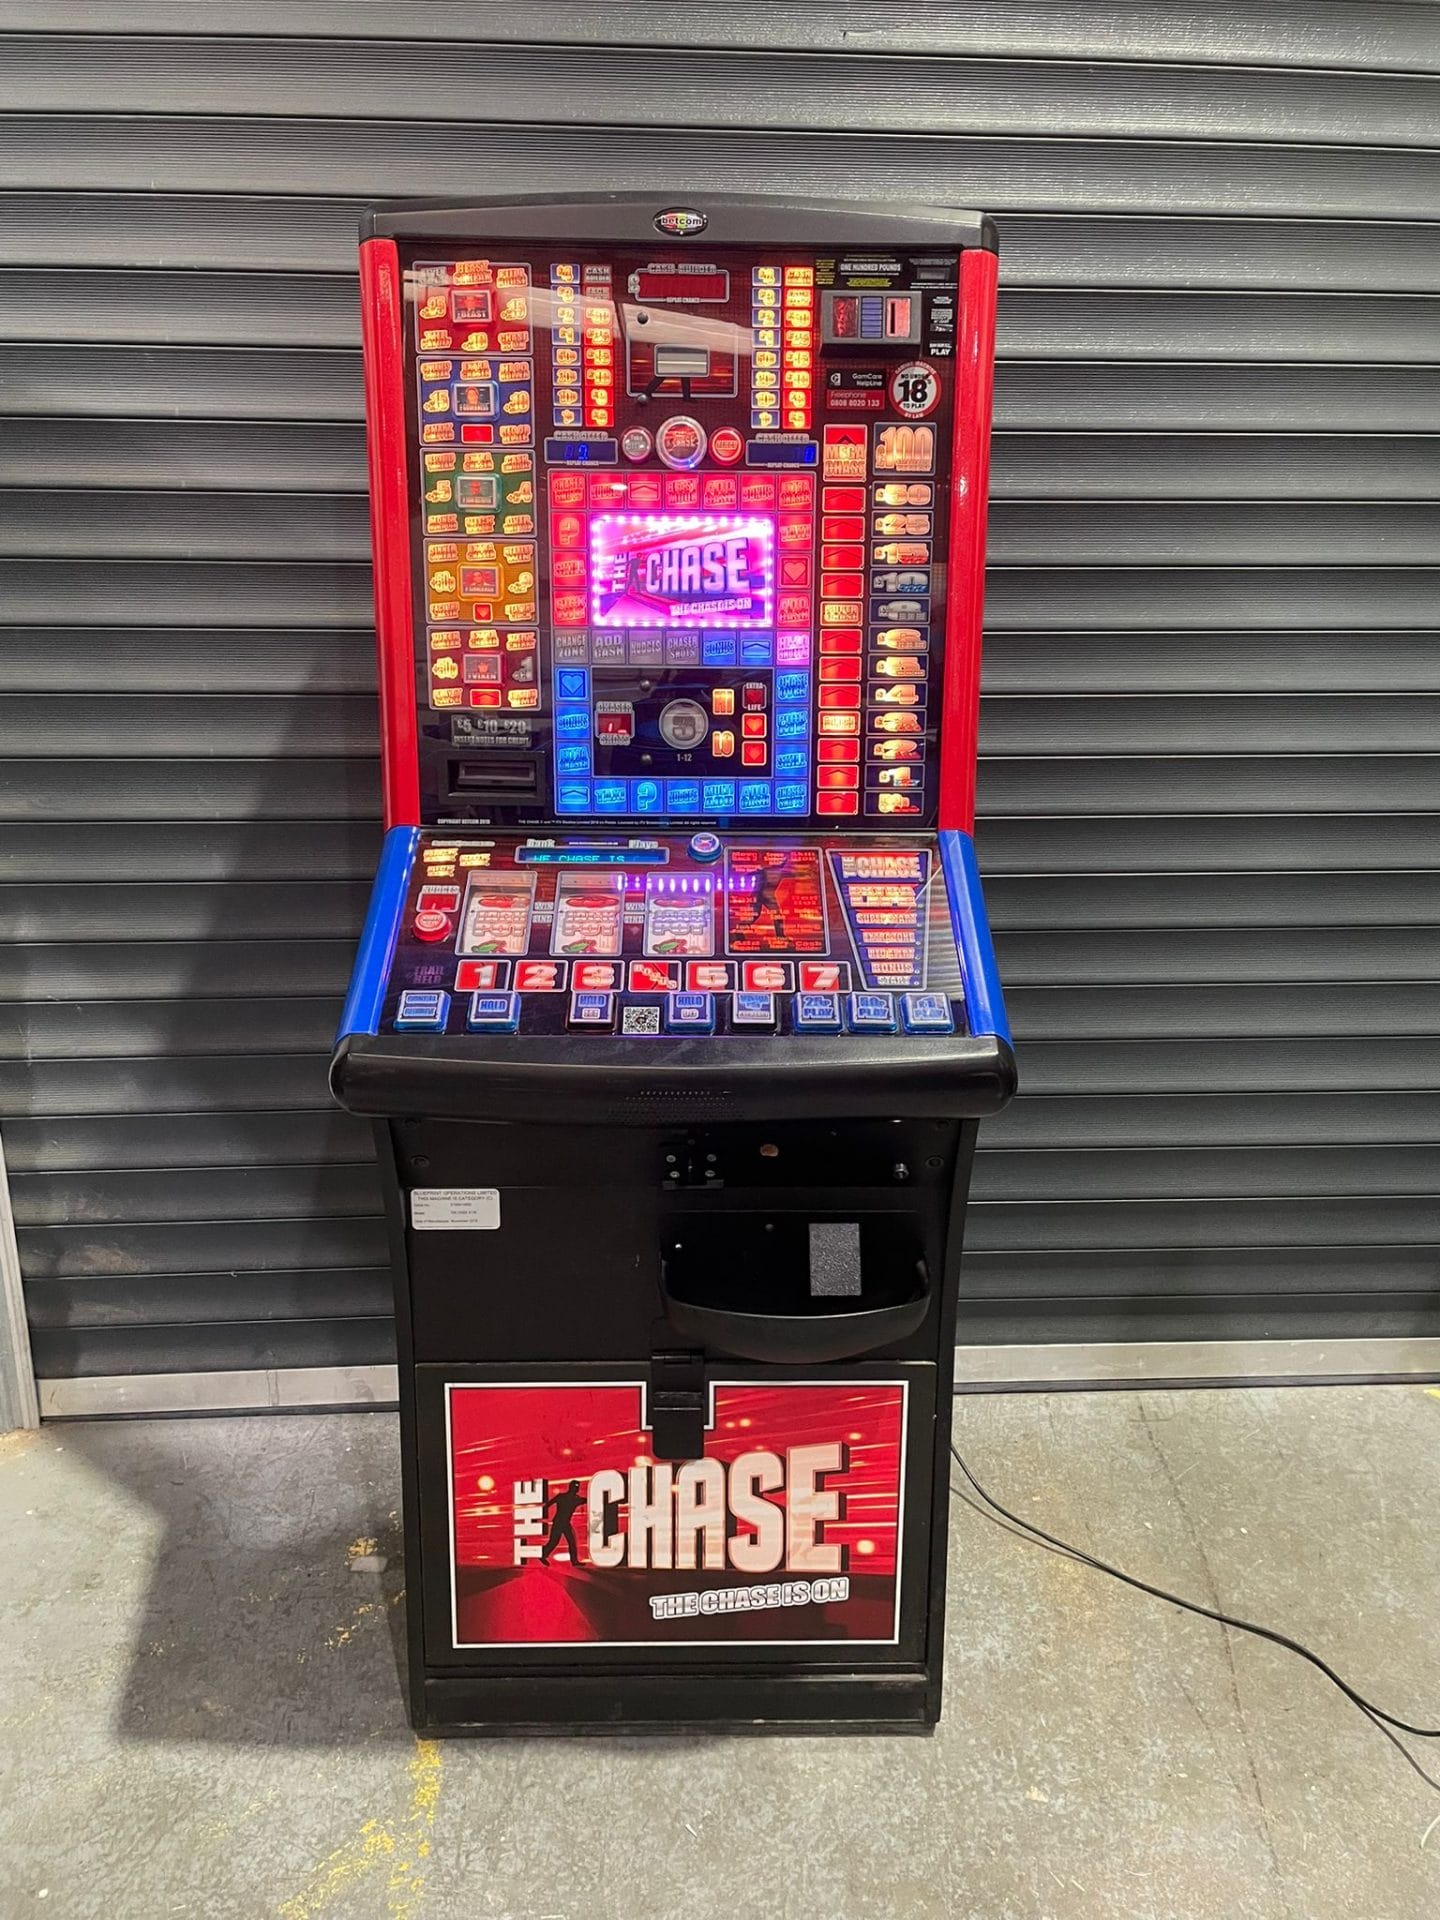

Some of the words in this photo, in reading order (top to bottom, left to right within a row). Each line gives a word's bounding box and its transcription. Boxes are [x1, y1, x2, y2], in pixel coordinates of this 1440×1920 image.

[661, 216, 702, 226] betcom
[840, 263, 853, 271] ONE
[853, 263, 879, 271] HUNDRED
[879, 263, 901, 271] POUNDS
[930, 348, 951, 356] PLAY
[830, 399, 848, 407] 0808
[849, 399, 866, 407] 8020
[826, 444, 865, 460] MEGA
[826, 460, 865, 475] CHASE
[612, 552, 628, 593] THE
[646, 537, 750, 594] CHASE
[725, 599, 737, 610] IS
[736, 597, 752, 609] ON
[596, 634, 622, 646] ADD
[594, 647, 623, 658] CASH
[704, 640, 735, 656] BONUS
[457, 718, 472, 733] £5
[477, 719, 498, 733] £10
[504, 720, 526, 734] £20
[558, 714, 589, 730] BONUS
[475, 736, 494, 744] NOTES
[507, 737, 529, 745] CREDIT
[527, 838, 555, 848] Bank
[628, 839, 659, 849] Plays
[857, 856, 922, 879] CHASE
[535, 902, 554, 911] WIN
[625, 902, 645, 911] WIN
[414, 966, 445, 975] TRAIL
[475, 965, 495, 986] 1
[523, 965, 558, 988] 2
[582, 965, 615, 987] 3
[696, 966, 729, 987] 5
[752, 966, 786, 987] 6
[807, 966, 840, 988] 7
[480, 1000, 507, 1012] HOLD
[578, 995, 605, 1007] HOLD
[676, 995, 704, 1007] HOLD
[803, 1008, 833, 1019] PLAY
[859, 1008, 889, 1019] PLAY
[914, 1008, 945, 1020] PLAY
[514, 1478, 547, 1565] THE
[588, 1441, 847, 1572] CHASE
[652, 1594, 698, 1619] THE
[700, 1584, 780, 1614] CHASE
[782, 1582, 809, 1605] IS
[812, 1578, 848, 1601] ON
